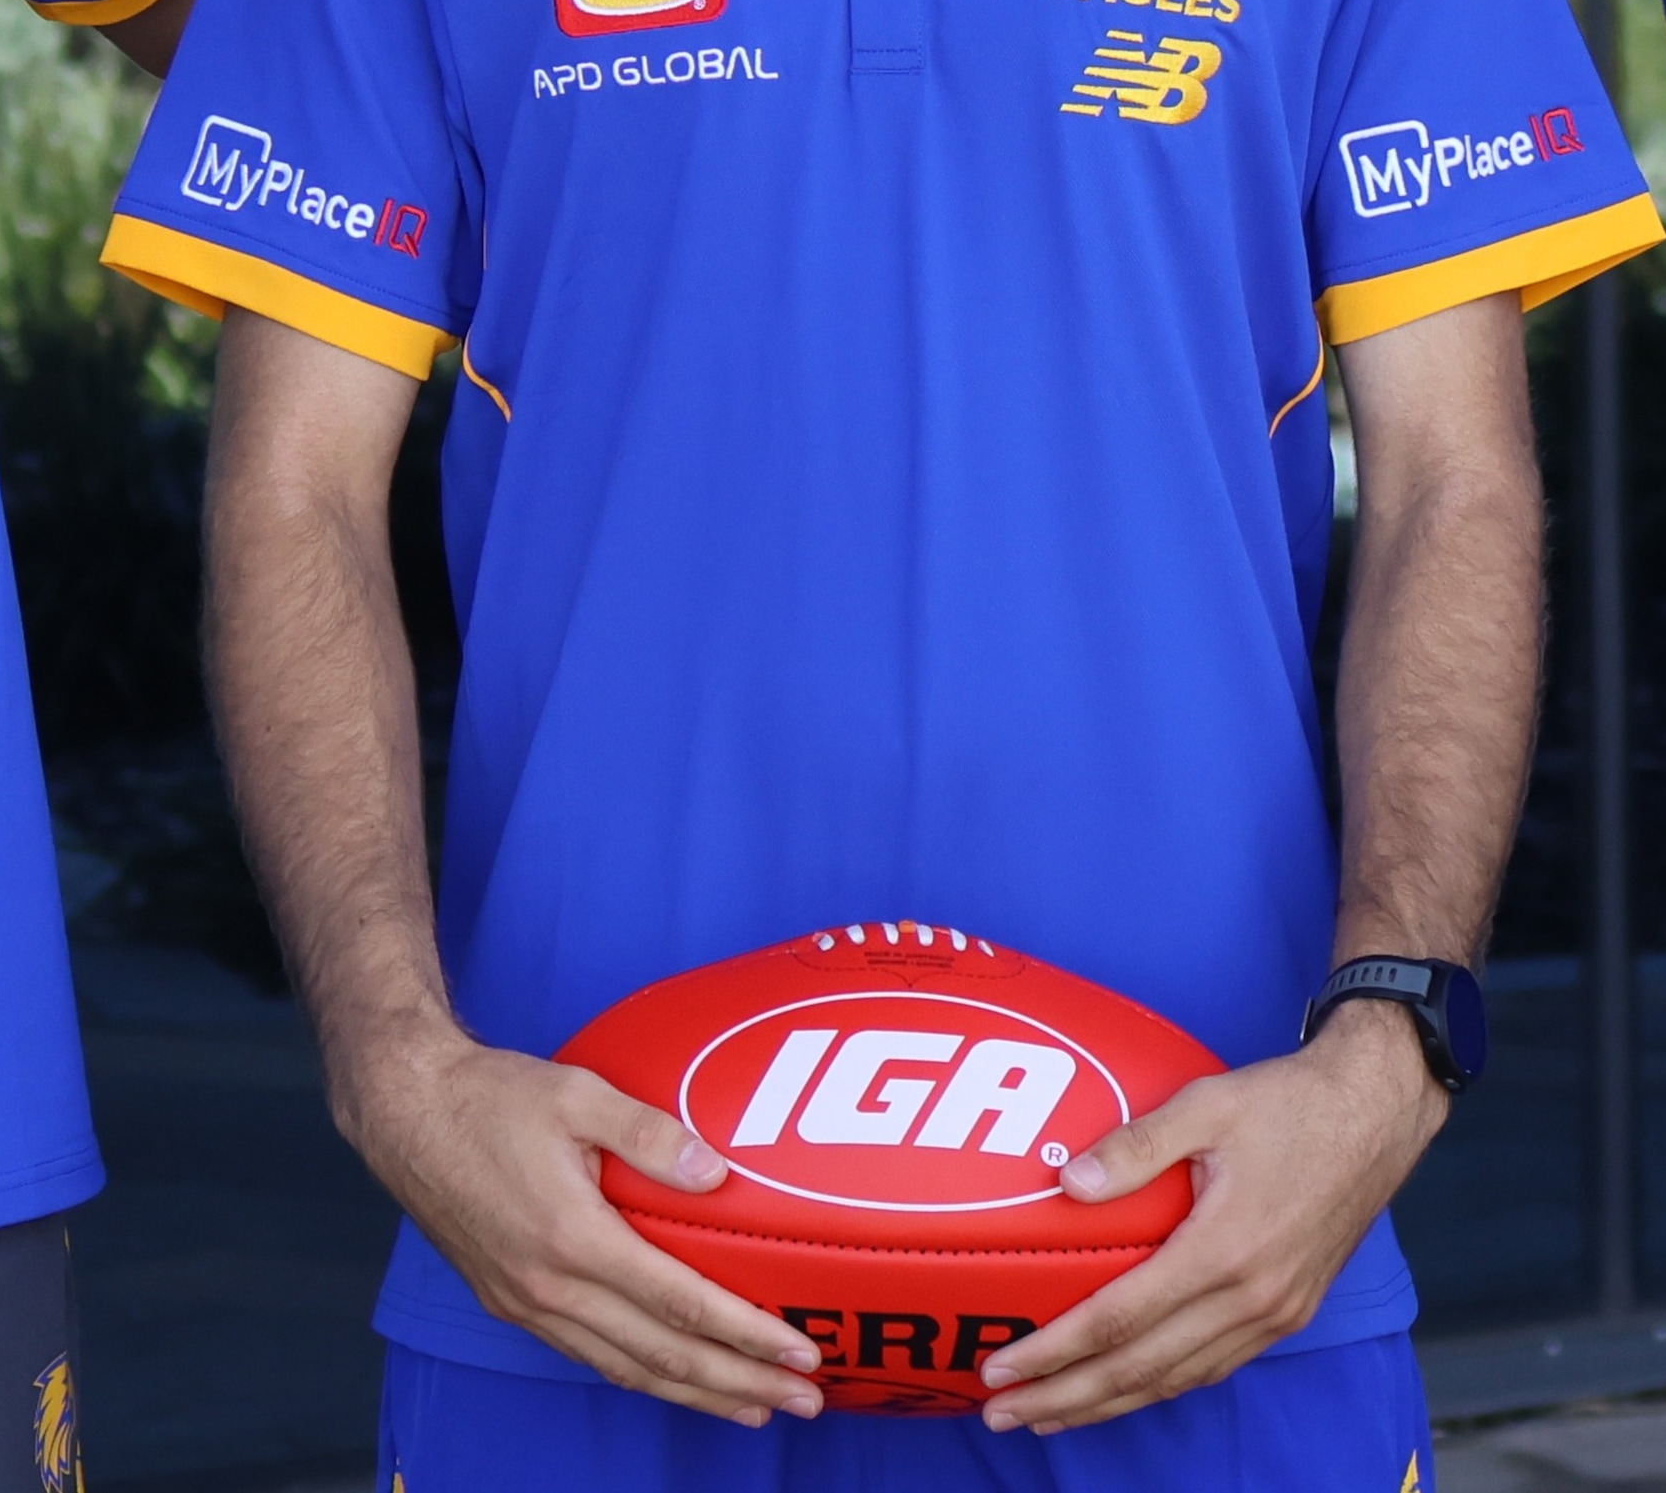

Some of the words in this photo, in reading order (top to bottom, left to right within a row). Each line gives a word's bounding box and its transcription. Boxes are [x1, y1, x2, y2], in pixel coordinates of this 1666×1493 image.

[534, 62, 603, 99] APD
[612, 46, 779, 86] GLOBAL
[729, 1029, 1077, 1157] IGA
